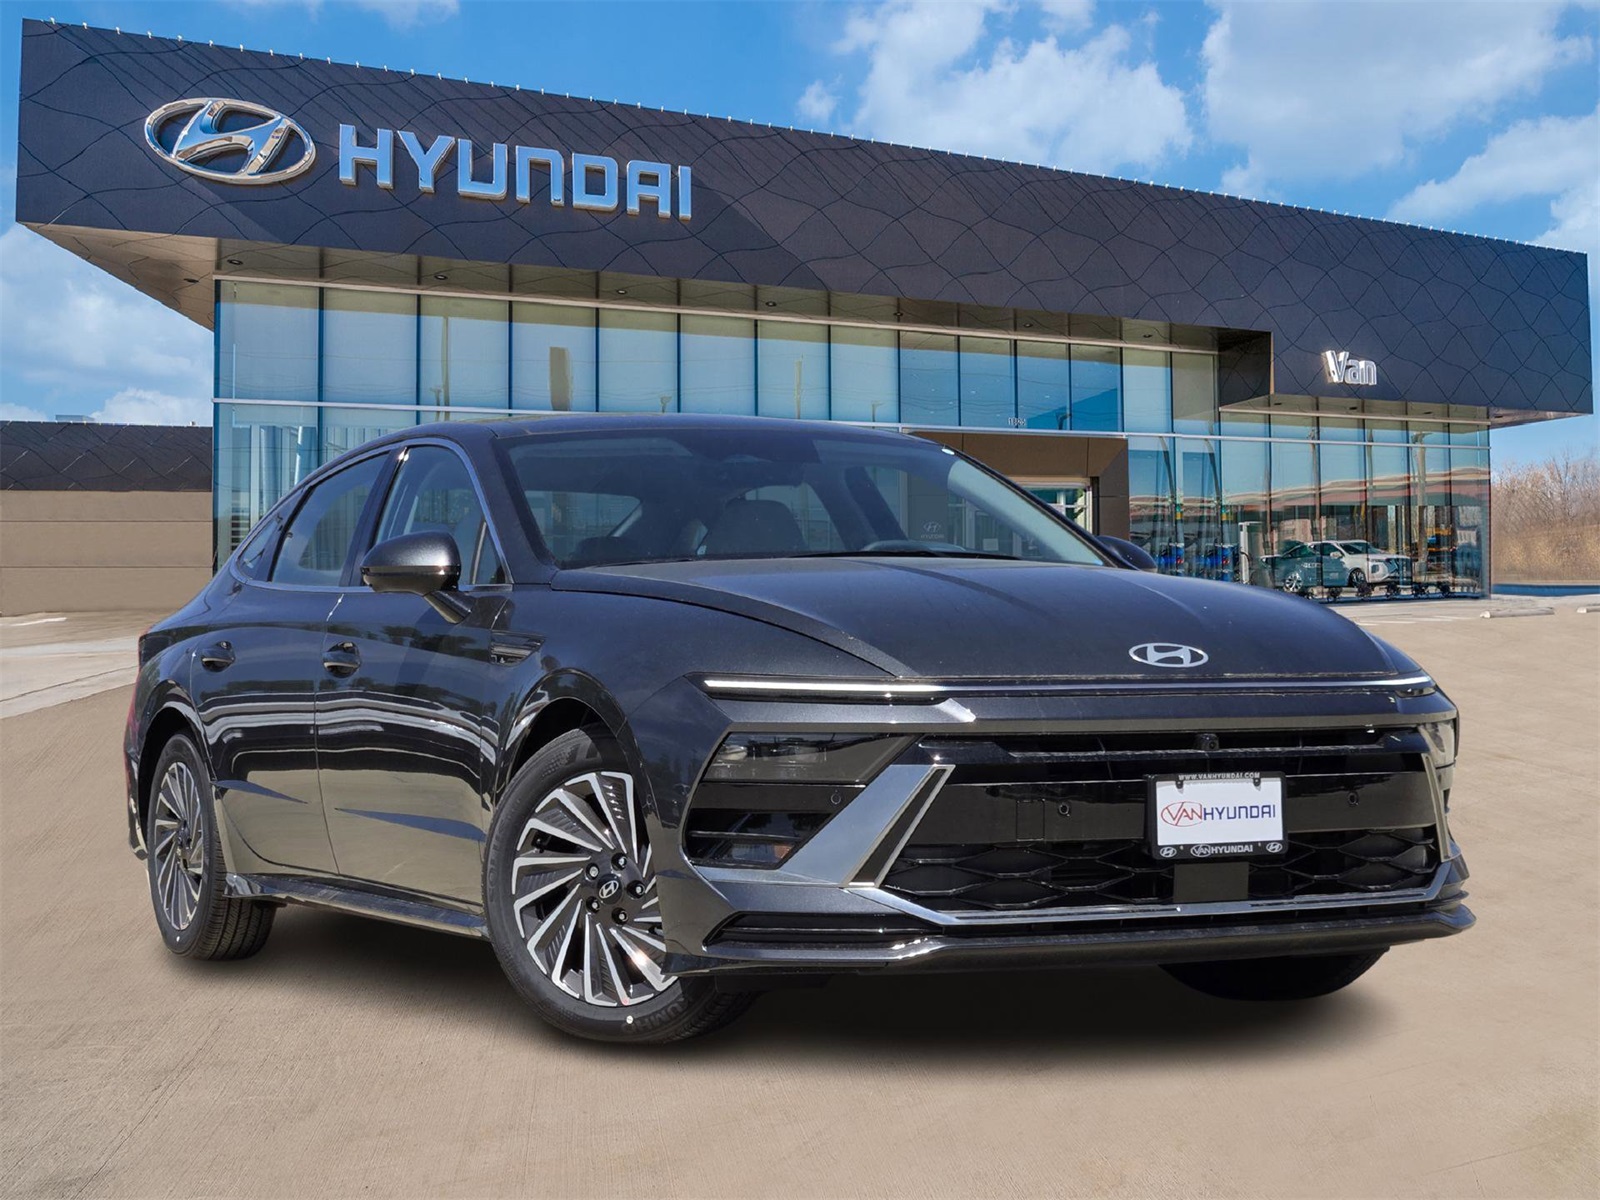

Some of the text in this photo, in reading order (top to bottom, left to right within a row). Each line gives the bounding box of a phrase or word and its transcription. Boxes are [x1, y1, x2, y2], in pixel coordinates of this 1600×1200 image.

[339, 123, 692, 221] HYUNDAI
[1322, 350, 1377, 386] Van
[1178, 771, 1260, 781] WWW.VANHYUNDAI.COM
